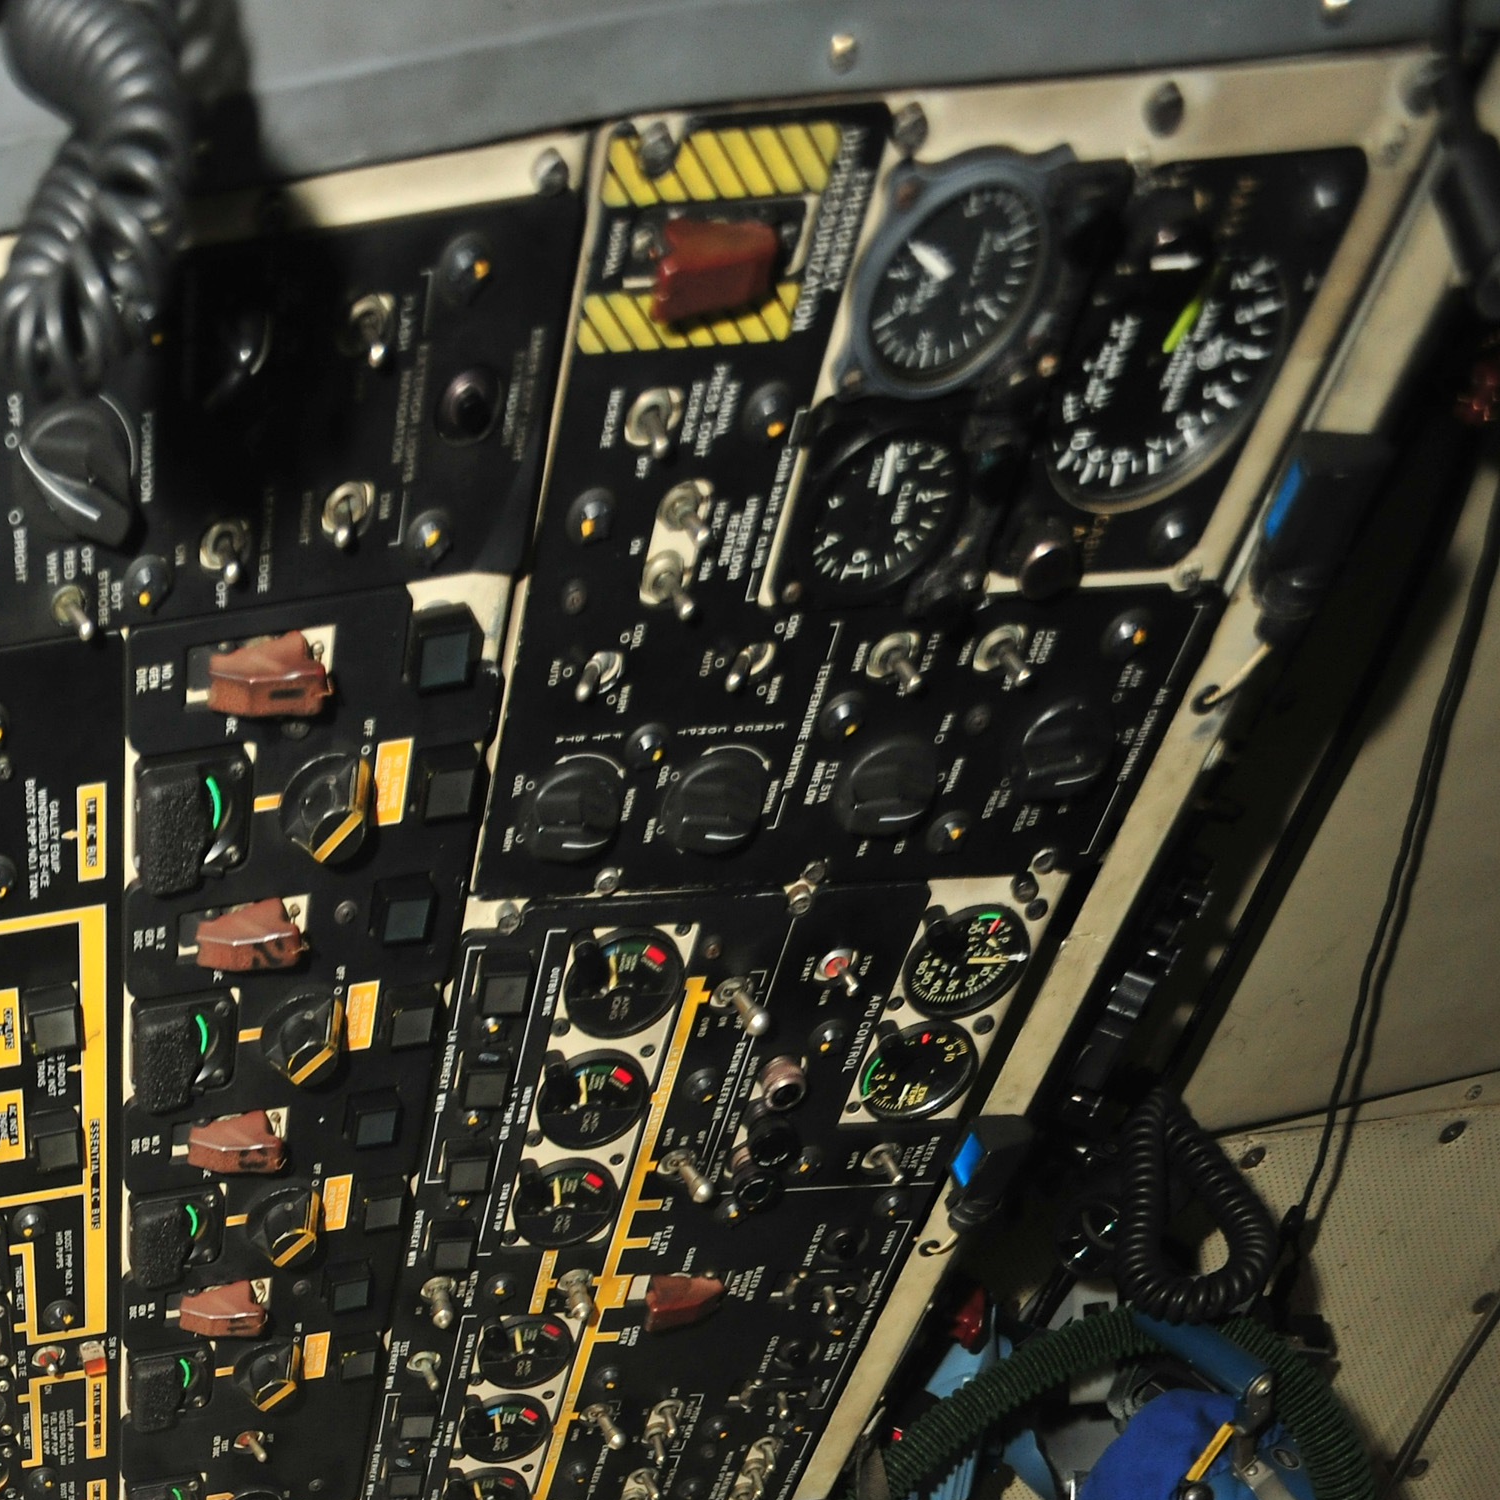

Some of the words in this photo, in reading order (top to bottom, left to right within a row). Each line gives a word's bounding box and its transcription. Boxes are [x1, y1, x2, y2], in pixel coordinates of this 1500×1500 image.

[828, 168, 869, 291] EMERGENCY
[704, 362, 730, 418] PRESS
[7, 393, 25, 427] OFF
[601, 387, 625, 448] INCREASE
[681, 381, 704, 445] DECREASE
[713, 379, 740, 440] MANUAL
[140, 411, 157, 503] FORMATION
[635, 455, 652, 479] OFF
[13, 528, 28, 583] BRIGHT
[718, 512, 742, 568] HEATING
[727, 496, 759, 582] UNDERFLOOR
[46, 551, 59, 585] WHT
[64, 549, 76, 580] RED
[81, 546, 93, 576] OFF
[97, 570, 111, 627] STROBE
[111, 581, 122, 612] BOT
[629, 623, 645, 651] COOL
[1026, 630, 1047, 665] COMPT
[1037, 630, 1057, 665] CARGO
[135, 667, 148, 695] DISC
[148, 665, 160, 691] GEN
[548, 660, 560, 687] AUTO
[616, 686, 632, 714] WARM
[798, 663, 832, 744] TEMPERATURE
[1152, 687, 1168, 705] AIR
[1116, 705, 1161, 783] CONDITIONING
[781, 744, 805, 792] CONTROL
[804, 761, 826, 807] AIRFLOW
[25, 779, 36, 815] BOOST
[85, 797, 96, 814] LH
[621, 787, 637, 822] NORMAL
[26, 816, 38, 848] PUMP
[36, 788, 49, 857] WINDSHIELD
[49, 799, 60, 839] GALLEY
[86, 823, 97, 839] AC
[39, 857, 50, 888] DE-ICE
[51, 840, 61, 874] EQUIP
[86, 844, 97, 867] BUS
[29, 870, 40, 900] TANK
[3, 1007, 14, 1049] COPILOTS
[88, 1118, 101, 1183] ESSENTIAL
[91, 1186, 101, 1204] AC
[91, 1207, 101, 1230] BUS
